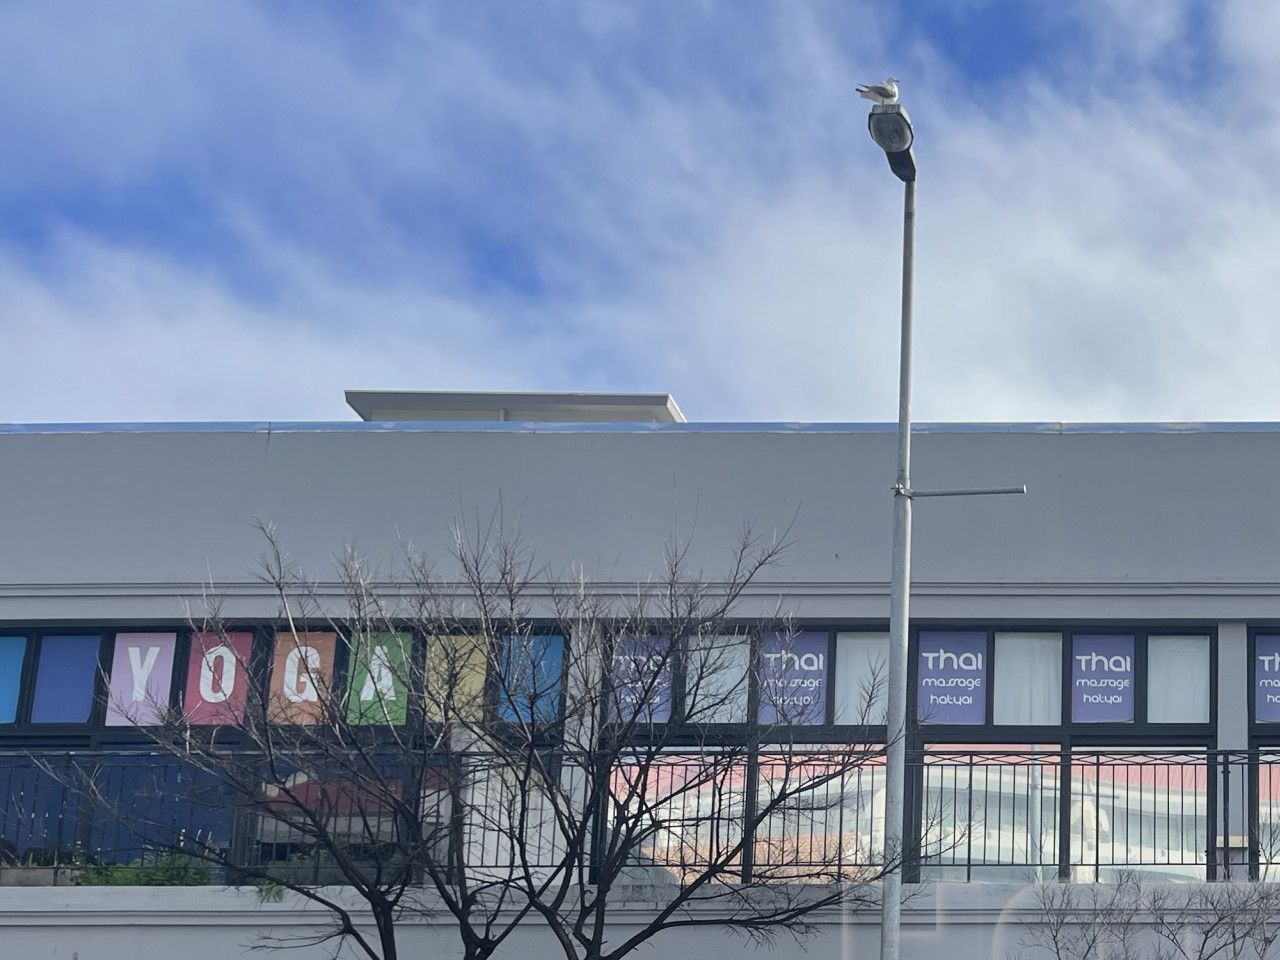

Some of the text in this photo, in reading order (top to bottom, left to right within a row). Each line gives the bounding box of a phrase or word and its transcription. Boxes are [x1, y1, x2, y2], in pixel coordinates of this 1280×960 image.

[922, 649, 983, 671] Thai
[1075, 651, 1131, 672] Thai
[128, 645, 397, 703] YOGA
[922, 678, 982, 690] massage
[1076, 678, 1130, 690] massage
[930, 694, 973, 706] hatyai
[1083, 693, 1122, 705] hatyai
